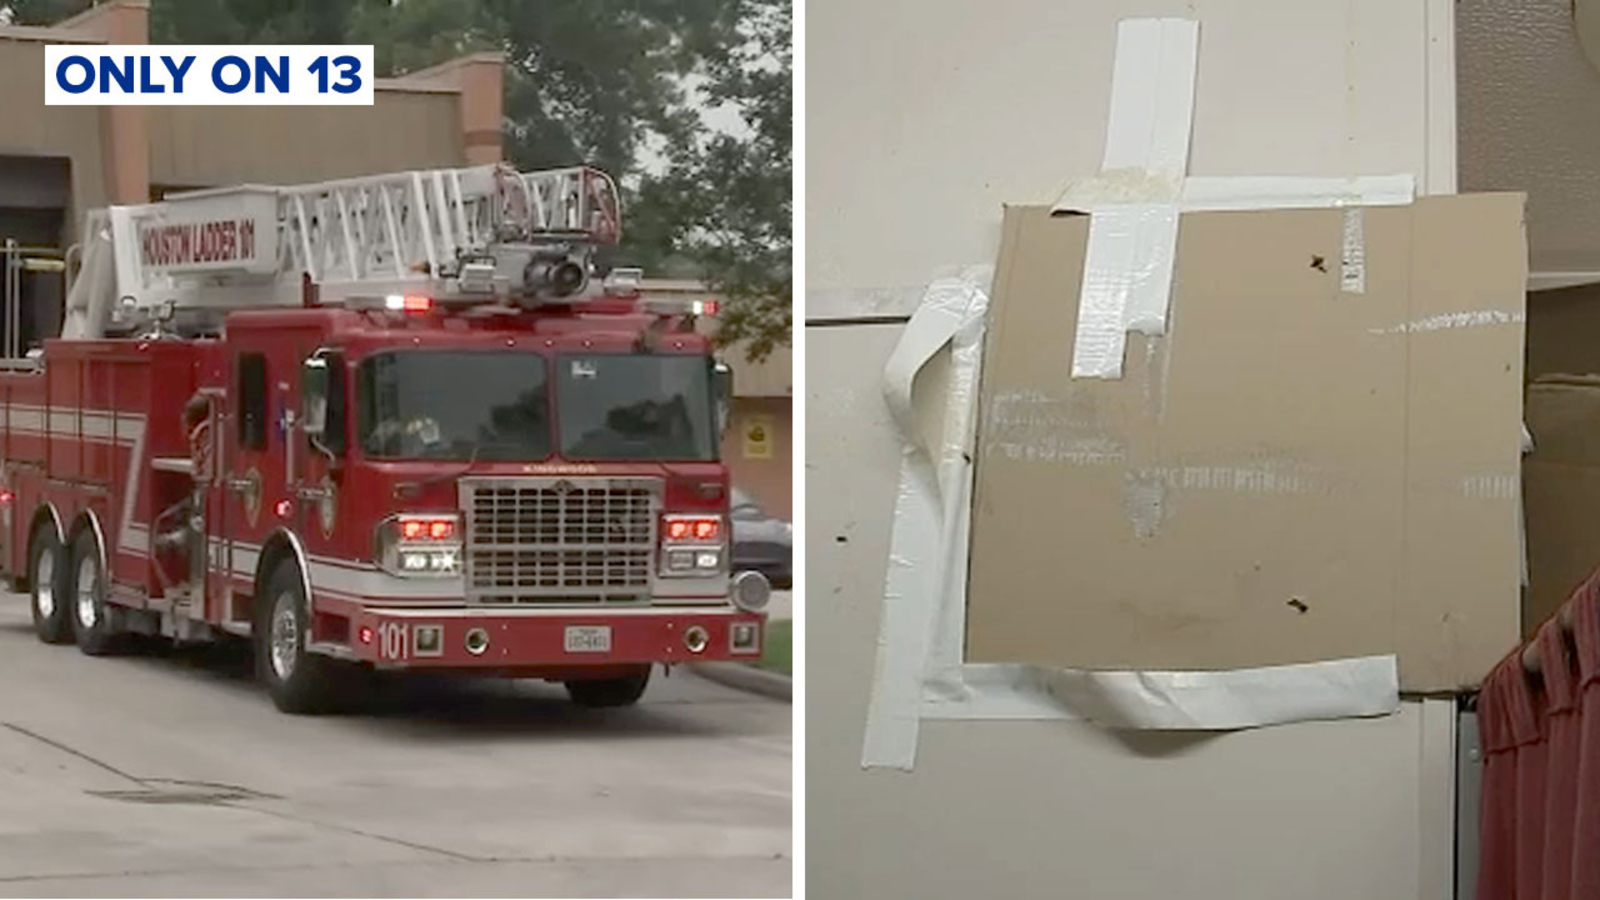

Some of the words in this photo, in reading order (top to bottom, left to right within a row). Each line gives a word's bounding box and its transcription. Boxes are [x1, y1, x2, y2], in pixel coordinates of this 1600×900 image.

[142, 226, 192, 265] HOUSTON
[193, 221, 237, 262] LADDER
[239, 218, 255, 260] 101
[378, 621, 408, 660] 101
